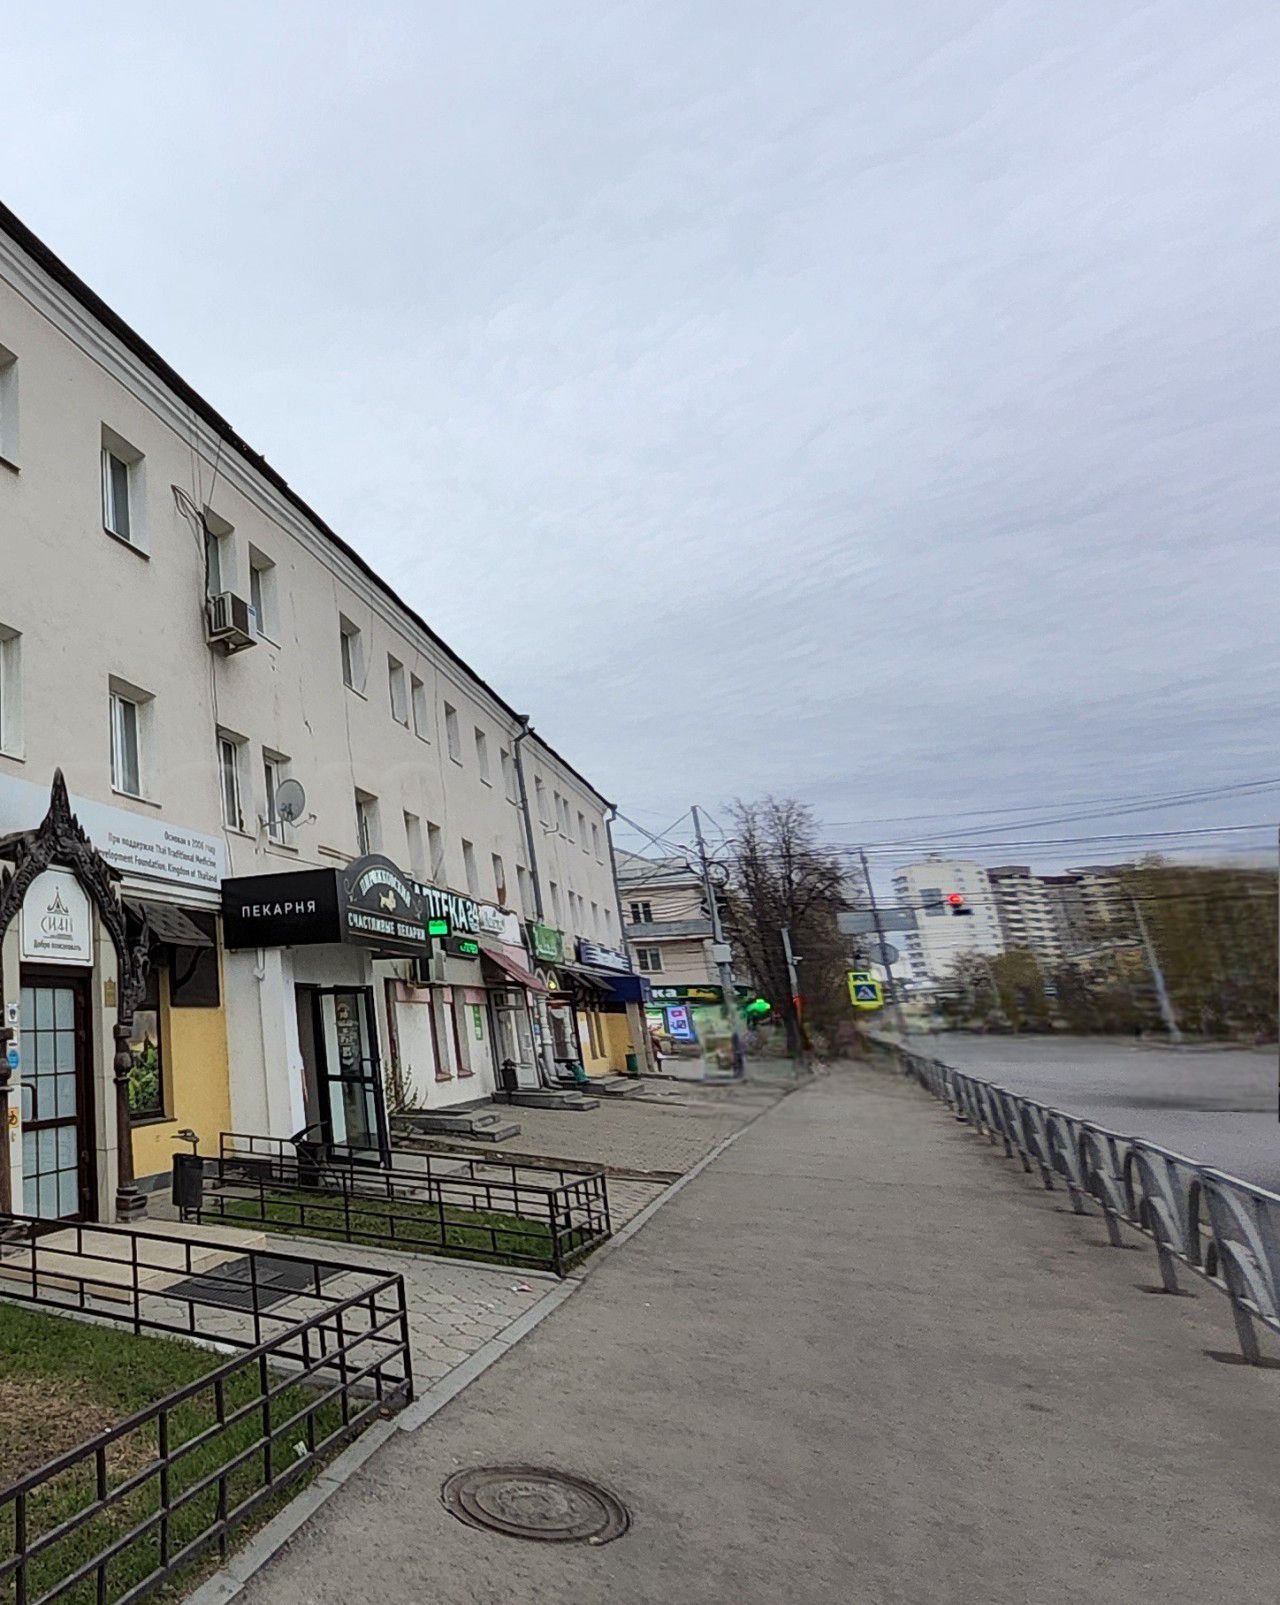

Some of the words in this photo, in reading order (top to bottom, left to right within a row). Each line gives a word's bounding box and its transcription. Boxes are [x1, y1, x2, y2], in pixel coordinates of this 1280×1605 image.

[167, 847, 194, 863] Traditional
[197, 869, 217, 883] Thailand
[242, 900, 316, 918] ПЕКАРНЯ
[414, 884, 469, 931] ПТЕКА
